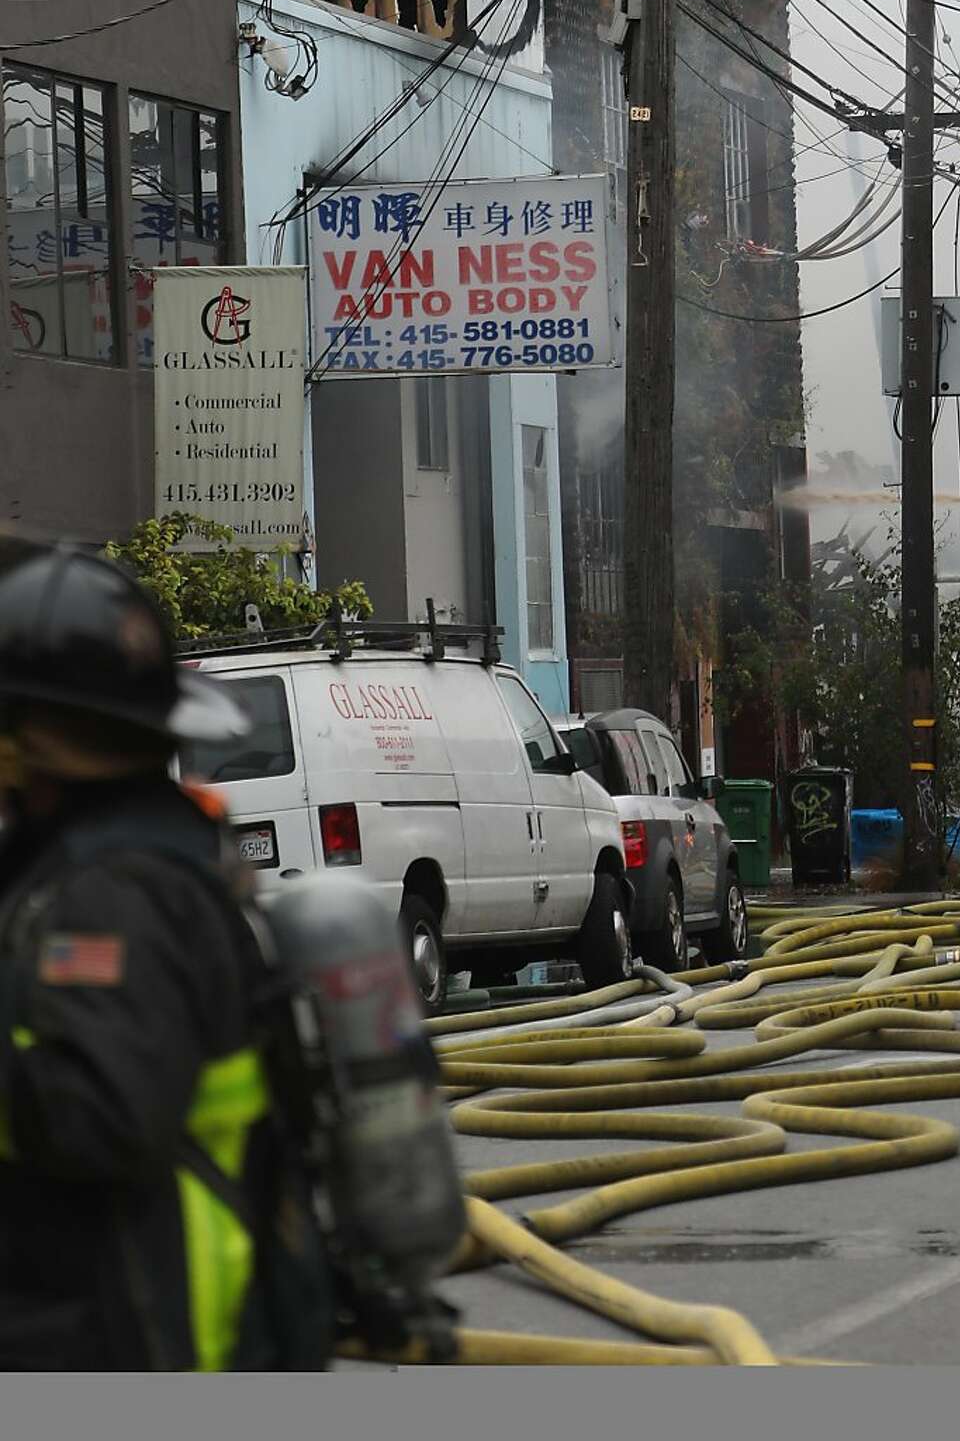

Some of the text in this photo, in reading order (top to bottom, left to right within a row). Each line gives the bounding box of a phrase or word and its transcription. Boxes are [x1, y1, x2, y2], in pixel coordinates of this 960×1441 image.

[443, 199, 594, 238] 車身修理
[323, 241, 597, 291] VAN NESS
[333, 286, 588, 321] AUTO BODY
[164, 351, 293, 370] GLASSALL
[184, 393, 281, 409] Commercial
[186, 419, 225, 435] Auto
[186, 443, 277, 459] Residential
[163, 483, 295, 502] 415.431.3202
[329, 683, 433, 720] GLASSALL
